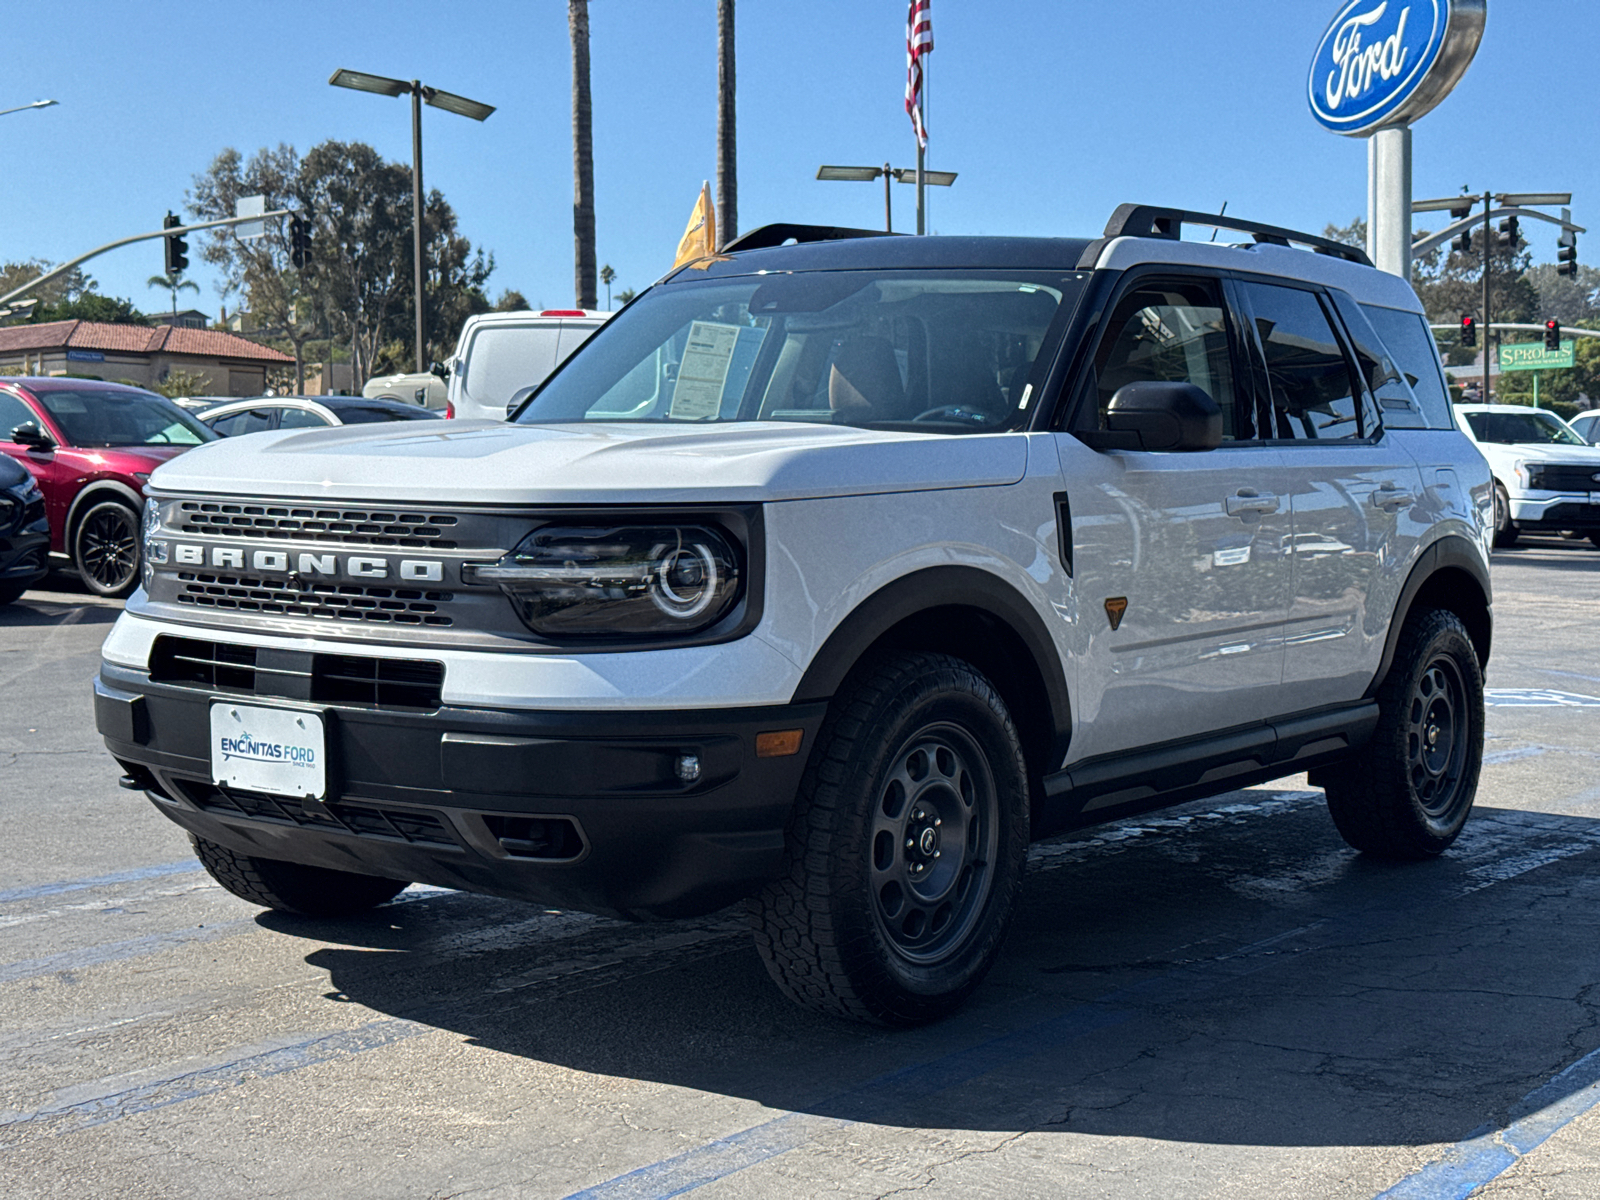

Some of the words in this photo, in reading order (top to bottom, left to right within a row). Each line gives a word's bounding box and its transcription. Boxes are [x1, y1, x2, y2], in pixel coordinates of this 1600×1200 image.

[1326, 1, 1410, 110] Ford
[175, 544, 444, 582] BRONCO
[221, 737, 282, 758] ENCINITAS
[283, 745, 315, 763] FORD
